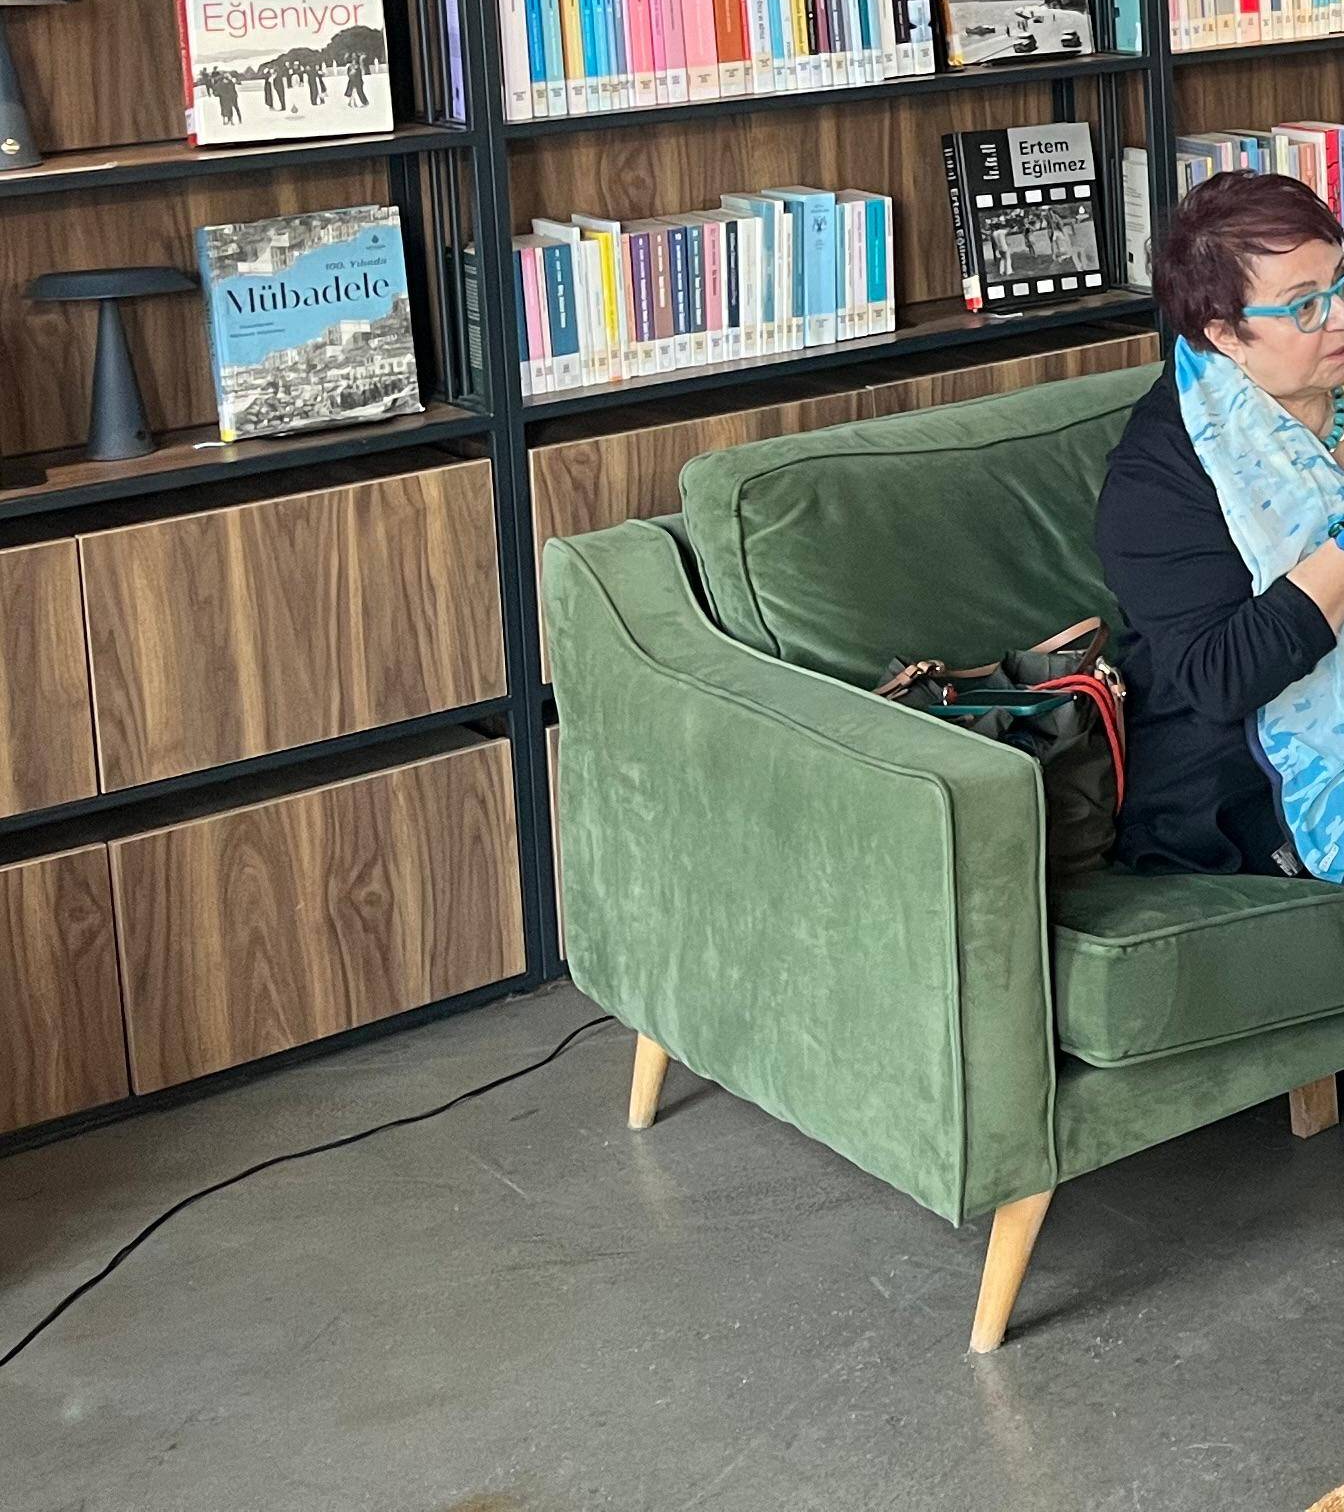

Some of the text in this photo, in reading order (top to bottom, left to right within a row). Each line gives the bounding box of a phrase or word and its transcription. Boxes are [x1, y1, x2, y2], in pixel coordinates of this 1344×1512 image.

[202, 0, 365, 38] Eğleniyor
[1018, 139, 1069, 155] Ertem
[1021, 158, 1086, 177] Eğilmez
[226, 272, 390, 317] Mübadele
